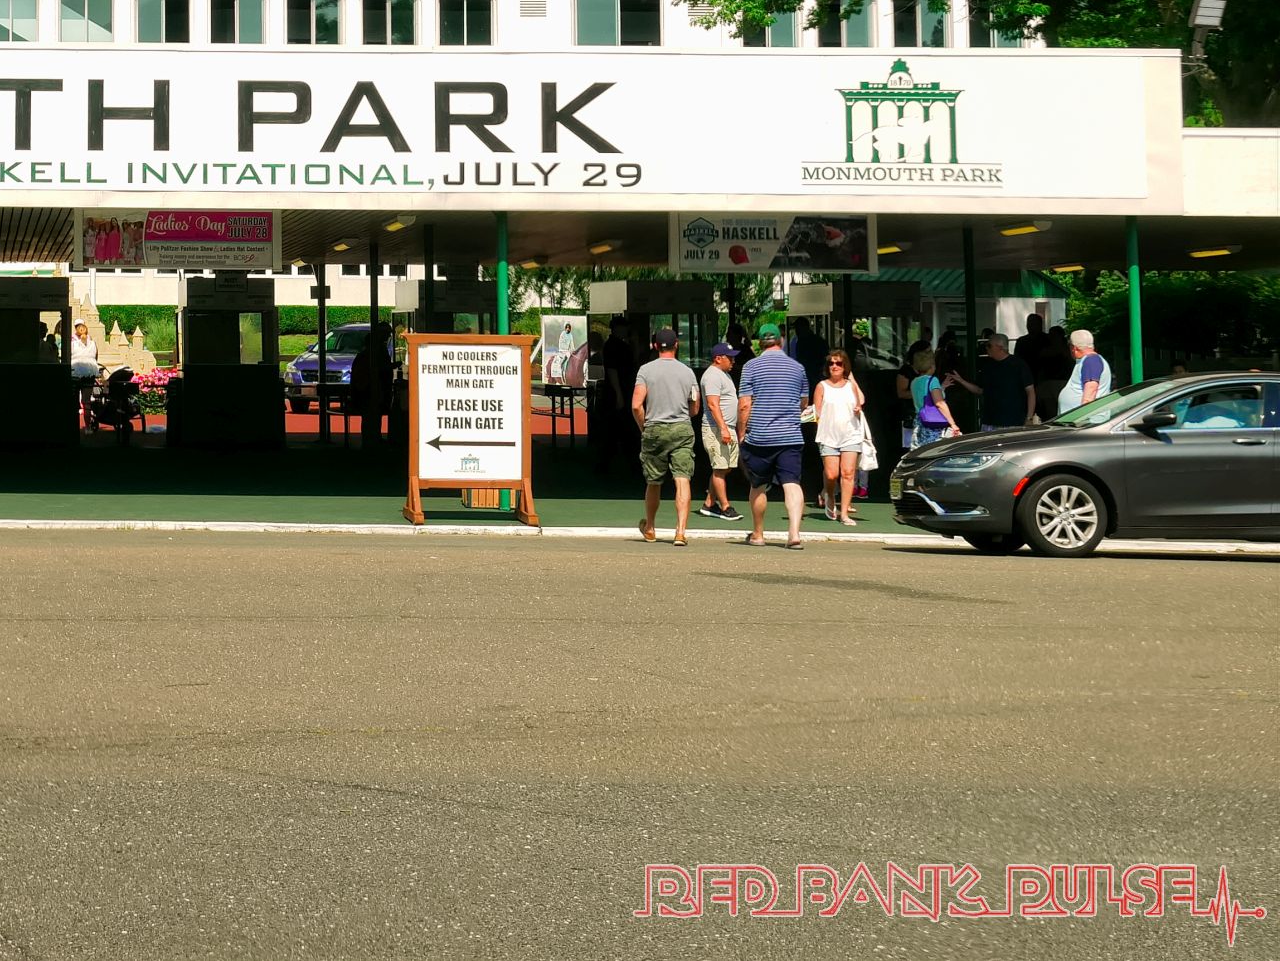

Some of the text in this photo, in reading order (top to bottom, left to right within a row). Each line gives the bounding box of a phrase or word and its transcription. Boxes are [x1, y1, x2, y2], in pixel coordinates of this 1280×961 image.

[237, 80, 623, 154] PARK
[127, 162, 435, 193] INVITATIONAL,
[442, 162, 560, 187] JULY
[582, 162, 643, 188] 29
[801, 166, 1004, 184] MONMOUTH PARK
[195, 215, 226, 236] Day
[227, 216, 267, 226] SATURDAY
[227, 227, 268, 238] JULY 28
[722, 226, 780, 240] HASKELL
[684, 249, 720, 260] JULY 29
[441, 350, 498, 362] NO COOLERS
[421, 364, 518, 376] PERMITTED THROUGH
[446, 378, 494, 389] MAIN GATE
[437, 399, 504, 412] PLEASE USE
[436, 417, 504, 430] TRAIN GATE
